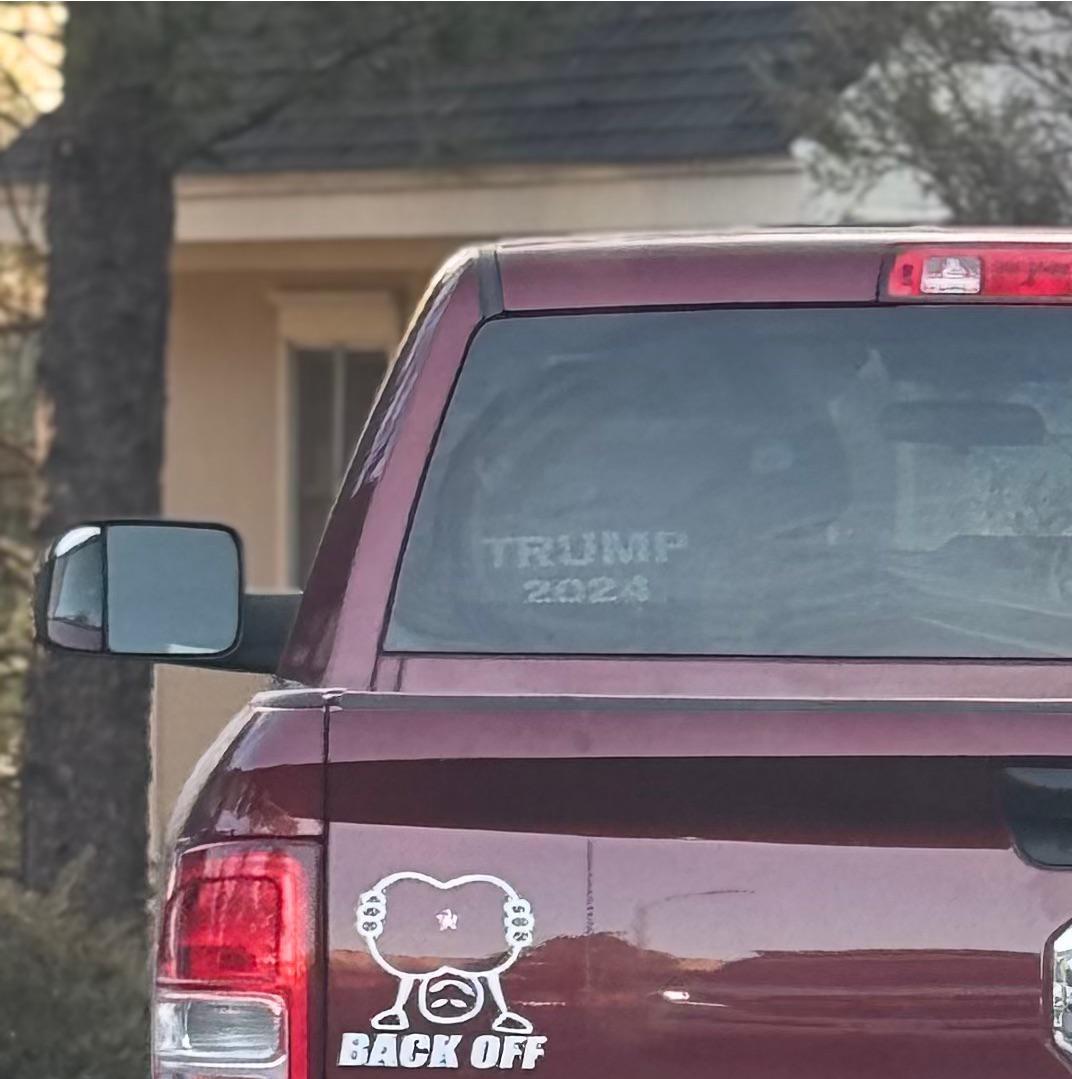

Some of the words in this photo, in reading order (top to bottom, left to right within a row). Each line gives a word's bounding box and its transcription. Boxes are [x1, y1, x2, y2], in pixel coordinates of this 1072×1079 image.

[480, 531, 689, 569] TRUMP
[522, 574, 649, 605] 2024
[337, 1032, 463, 1069] BACK
[470, 1034, 548, 1070] OFF
